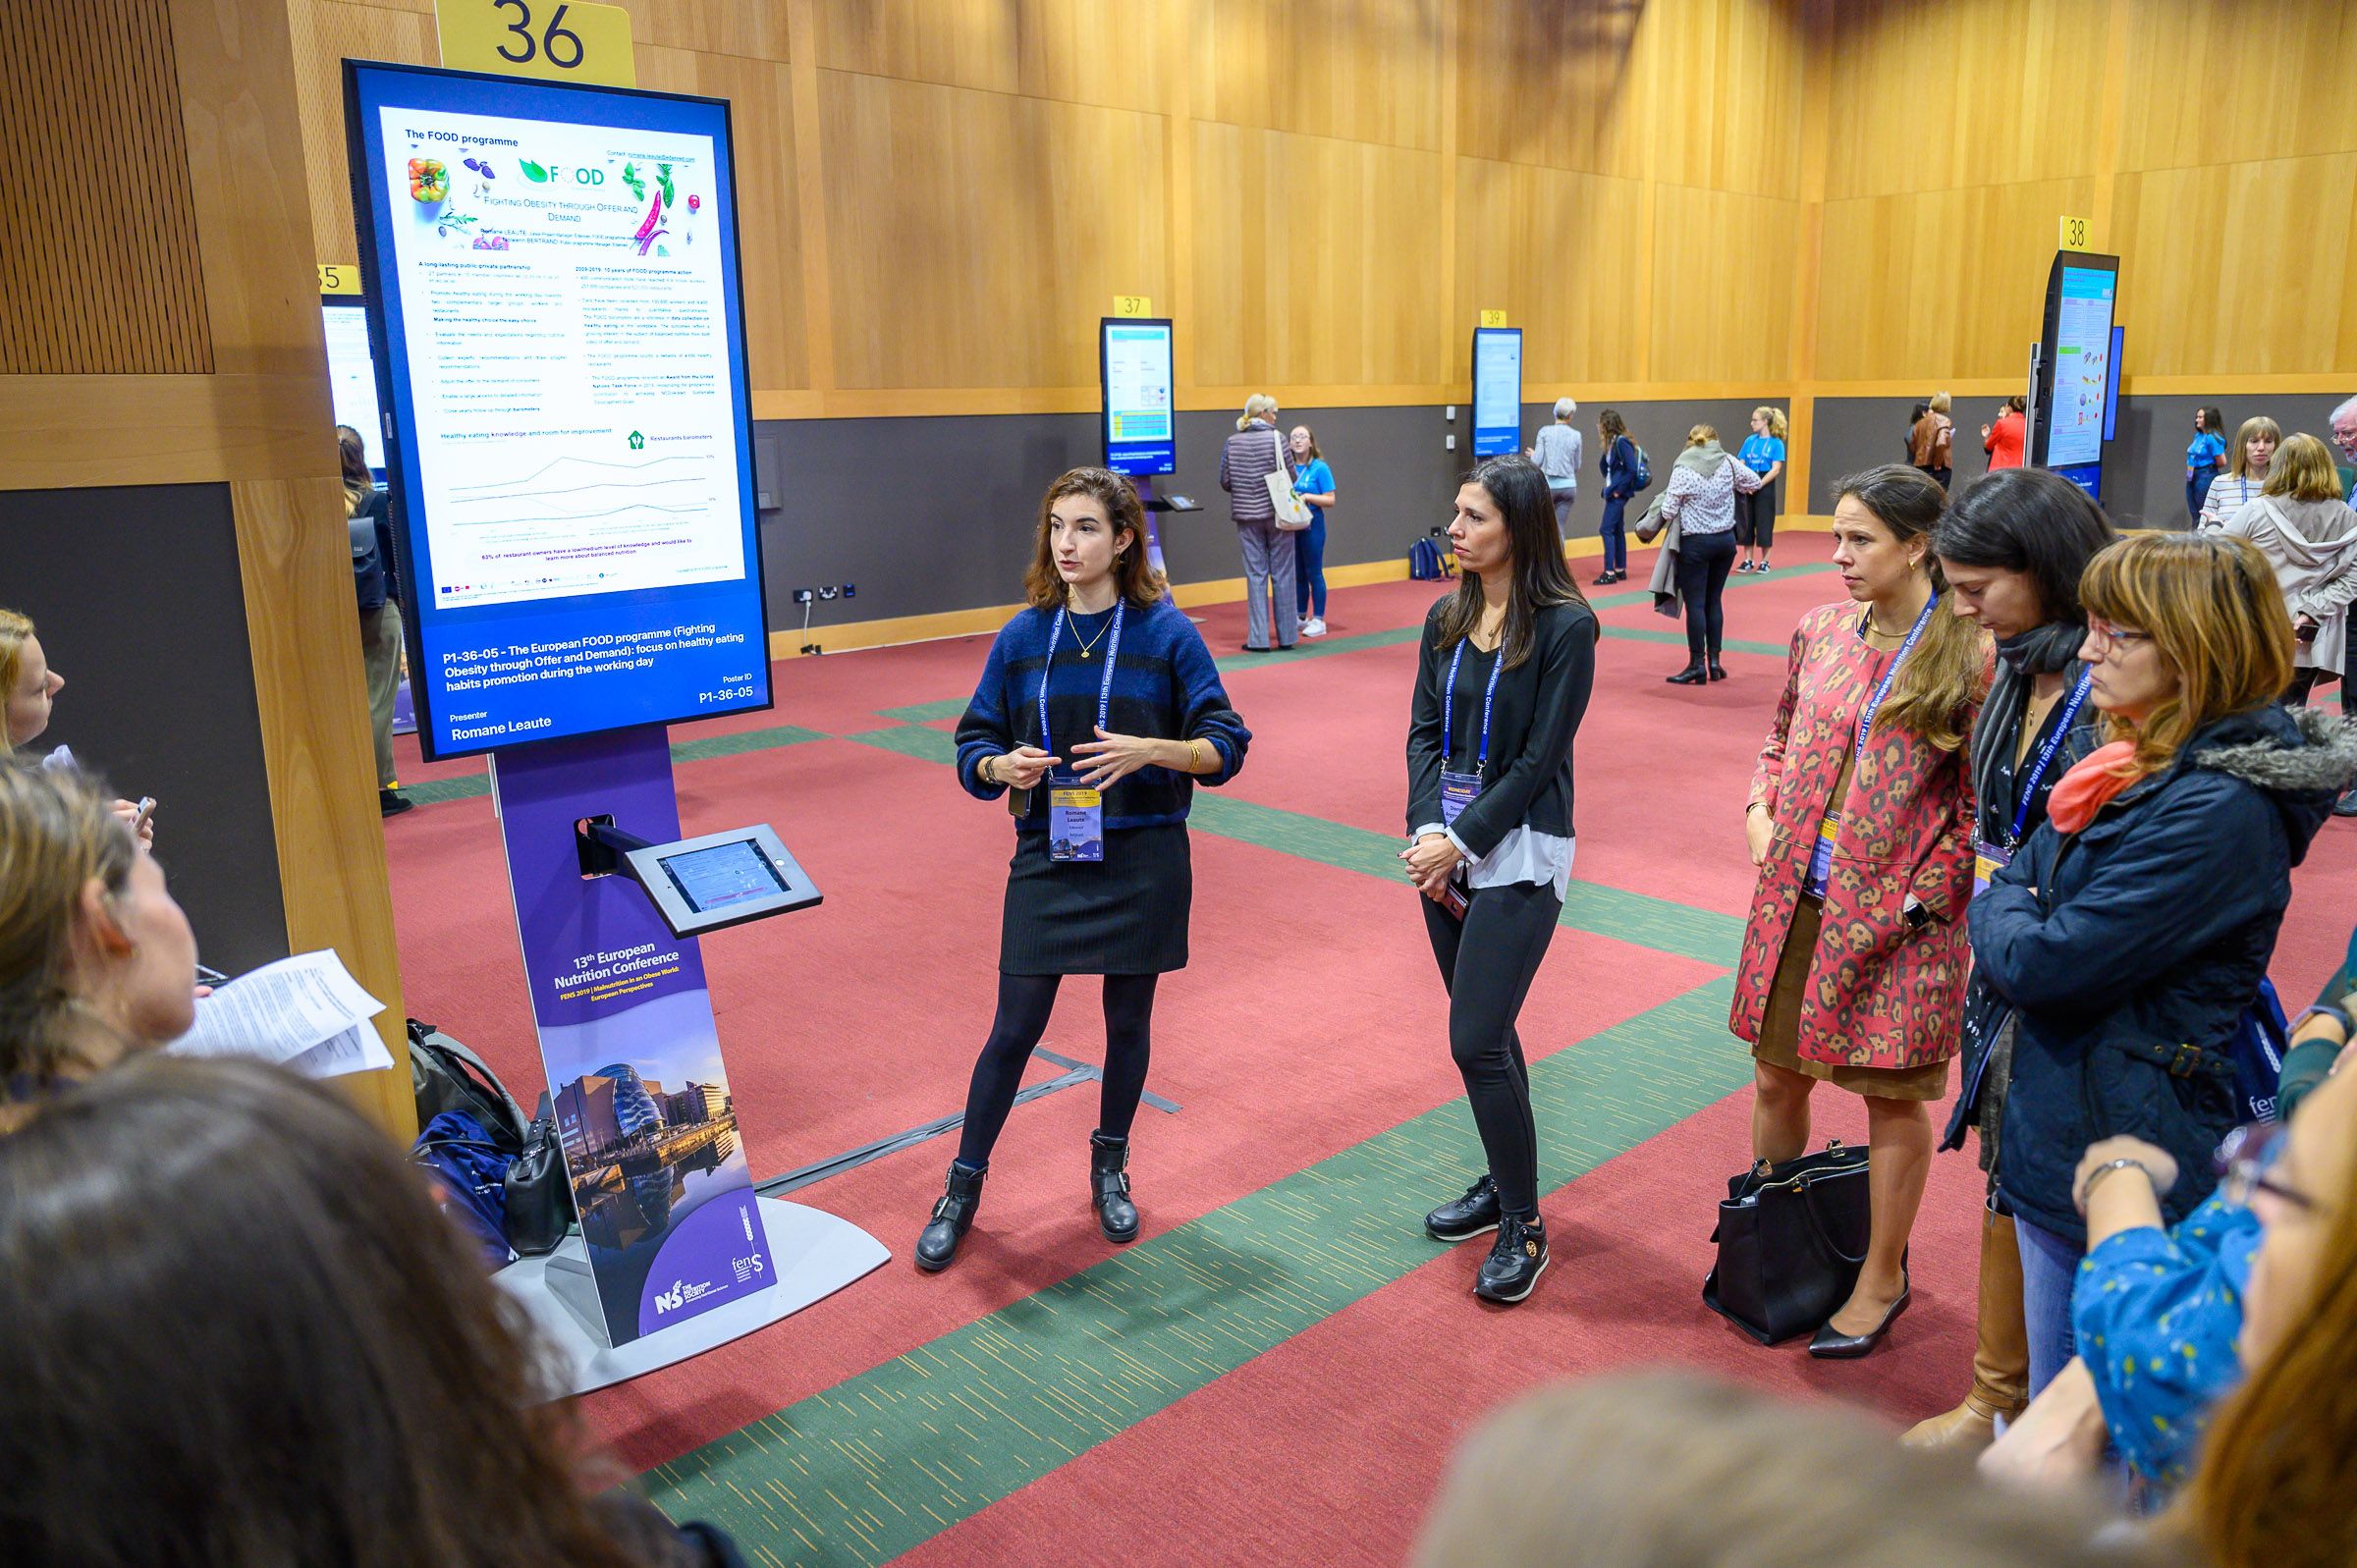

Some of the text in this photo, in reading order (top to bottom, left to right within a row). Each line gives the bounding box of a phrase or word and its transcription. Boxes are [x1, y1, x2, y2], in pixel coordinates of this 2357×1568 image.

[496, 0, 584, 69] 36
[406, 129, 519, 147] The FOOD programme
[2069, 219, 2085, 246] 38
[1124, 297, 1141, 314] 37
[1488, 311, 1500, 325] 39
[468, 431, 490, 440] eating
[491, 429, 527, 439] knowledge
[571, 427, 613, 436] improvement
[623, 541, 650, 550] knowledge
[1055, 607, 1065, 626] Confe
[443, 622, 716, 665] P1-36-05 The European FOOD programme (Fighting
[445, 631, 745, 678] Obesity through Offer and Demand): focus on healthy eating
[1103, 657, 1115, 686] European
[1109, 629, 1119, 657] Nutrition
[446, 656, 655, 692] habits promotion during the working day
[723, 673, 753, 684] Poster ID
[1447, 666, 1457, 695] Nutrition
[1486, 668, 1500, 696] Nutrition
[1858, 728, 1867, 745] 2019
[1864, 707, 1876, 724] 13th
[1871, 676, 1893, 708] European
[1889, 645, 1910, 676] Nutrition
[1906, 608, 1933, 646] Conference
[699, 685, 754, 704] P1-36-05
[449, 710, 488, 723] Presenter
[1039, 698, 1048, 736] Conference
[1482, 696, 1492, 734] Conference
[452, 717, 552, 741] Romane Leaute
[2021, 784, 2034, 806] FENS
[2029, 765, 2043, 785] 2019
[2042, 744, 2055, 762] 13th
[2050, 707, 2074, 748] European
[574, 942, 655, 969] 13th European
[554, 950, 680, 990] Nutrition Conference
[560, 991, 576, 1000] FENS
[576, 988, 590, 998] 2019
[593, 978, 630, 993] Malnutrition
[643, 970, 661, 981] Obese
[591, 982, 654, 1002] European Perspectives
